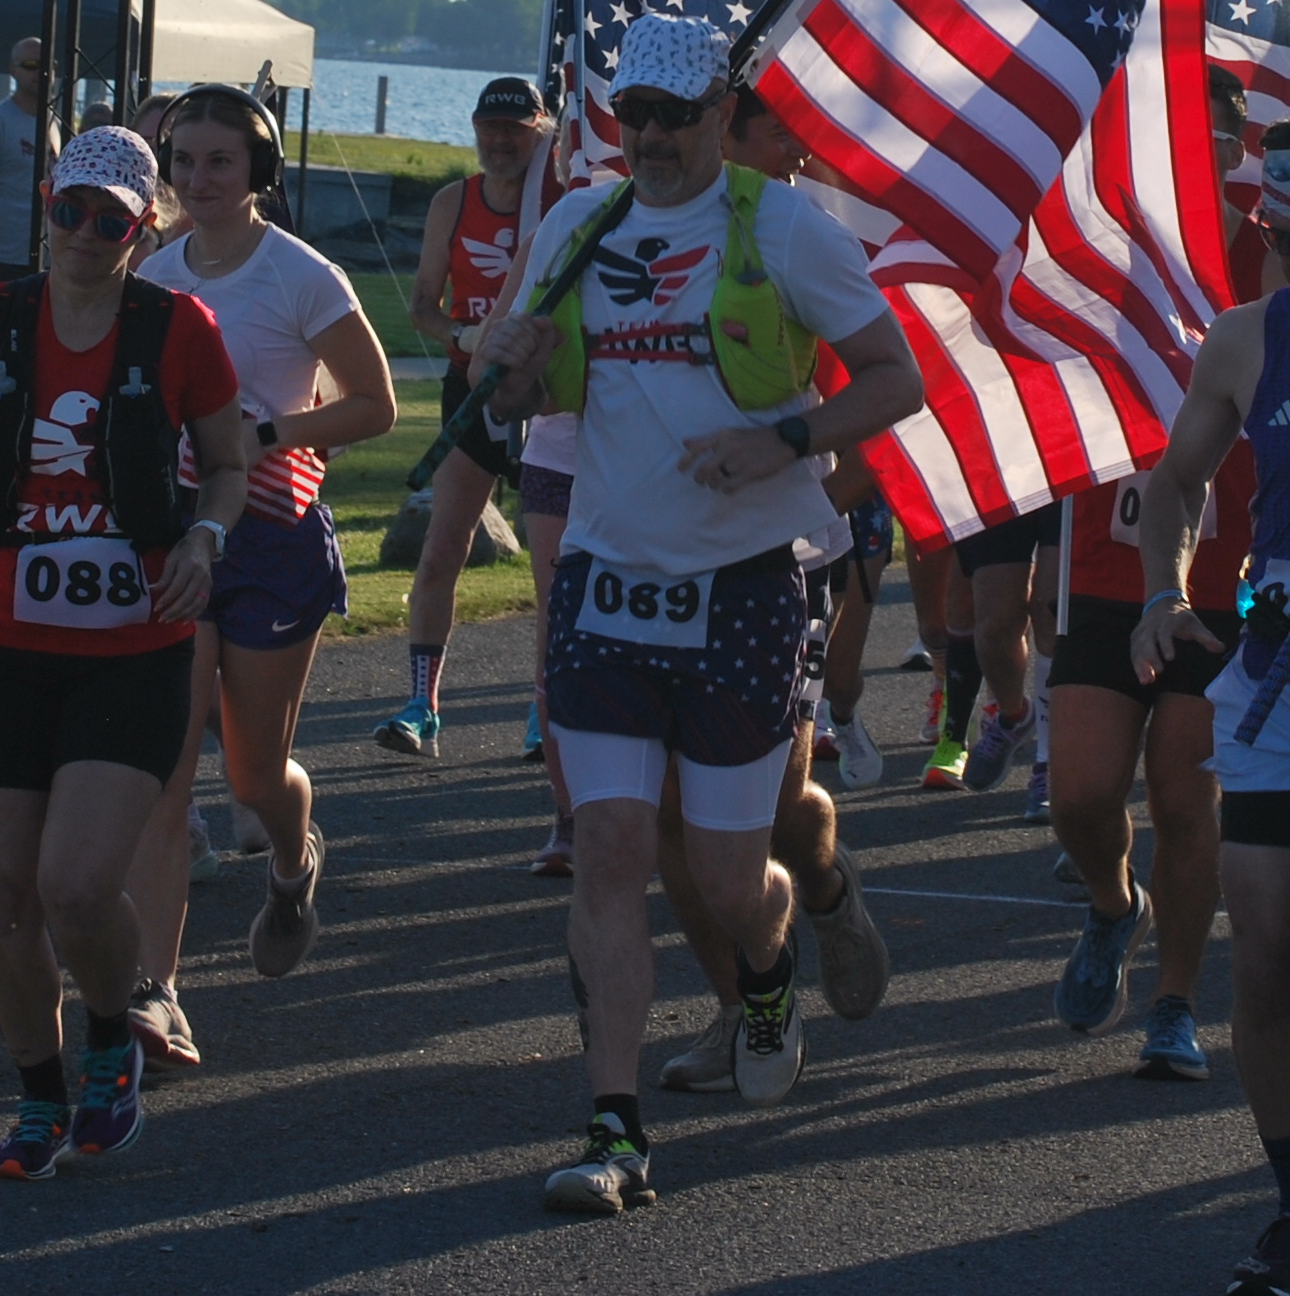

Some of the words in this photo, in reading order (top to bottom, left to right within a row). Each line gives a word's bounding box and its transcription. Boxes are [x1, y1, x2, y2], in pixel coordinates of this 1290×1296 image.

[485, 93, 525, 105] RWB
[25, 556, 142, 606] 088
[594, 571, 700, 623] 089
